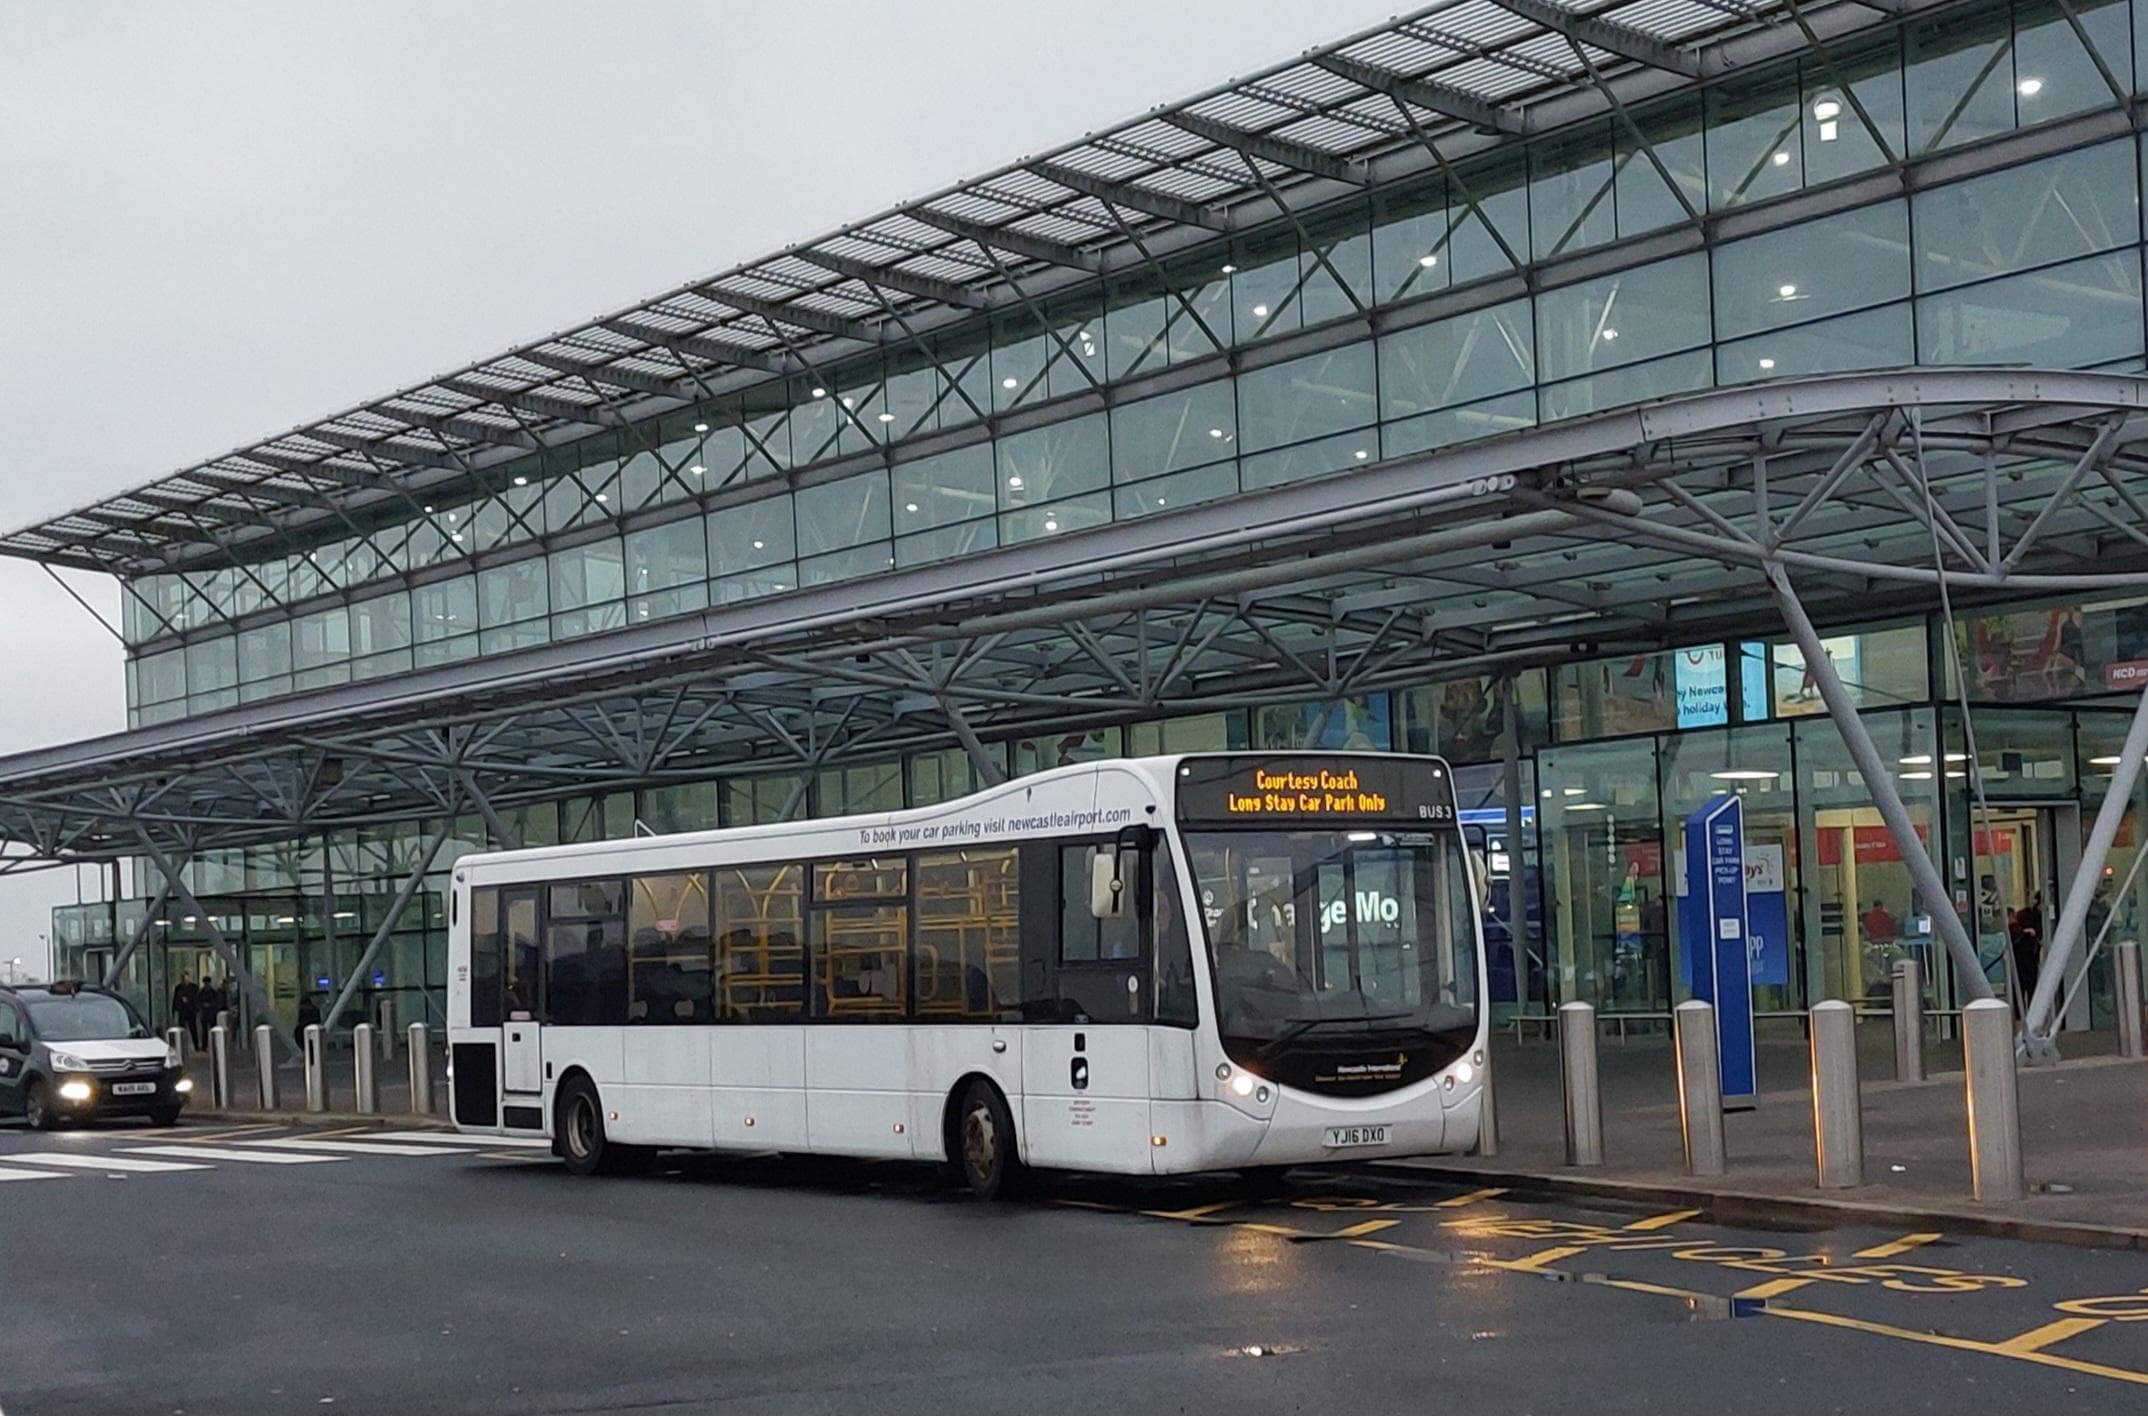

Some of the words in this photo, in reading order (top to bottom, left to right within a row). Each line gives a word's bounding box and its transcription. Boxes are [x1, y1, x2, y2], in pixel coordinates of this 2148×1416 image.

[1689, 686, 1724, 697] Newca
[1683, 702, 1721, 716] holiday
[1256, 769, 1318, 791] Courtesy
[1320, 769, 1358, 790] Coach
[1229, 793, 1261, 813] Long
[1265, 793, 1295, 813] Stay
[1299, 793, 1321, 812] Car
[1325, 793, 1355, 812] Park
[1358, 793, 1386, 813] Only
[1418, 805, 1443, 819] BUS
[1444, 806, 1452, 818] 3
[860, 830, 871, 844] To
[873, 828, 896, 844] book
[899, 828, 921, 845] your
[923, 826, 940, 840] car
[942, 821, 981, 841] parking
[983, 816, 1005, 834] visit
[1007, 807, 1132, 832] newcastleairport.com
[1332, 1128, 1359, 1145] YJ16
[1362, 1127, 1385, 1143] DXO
